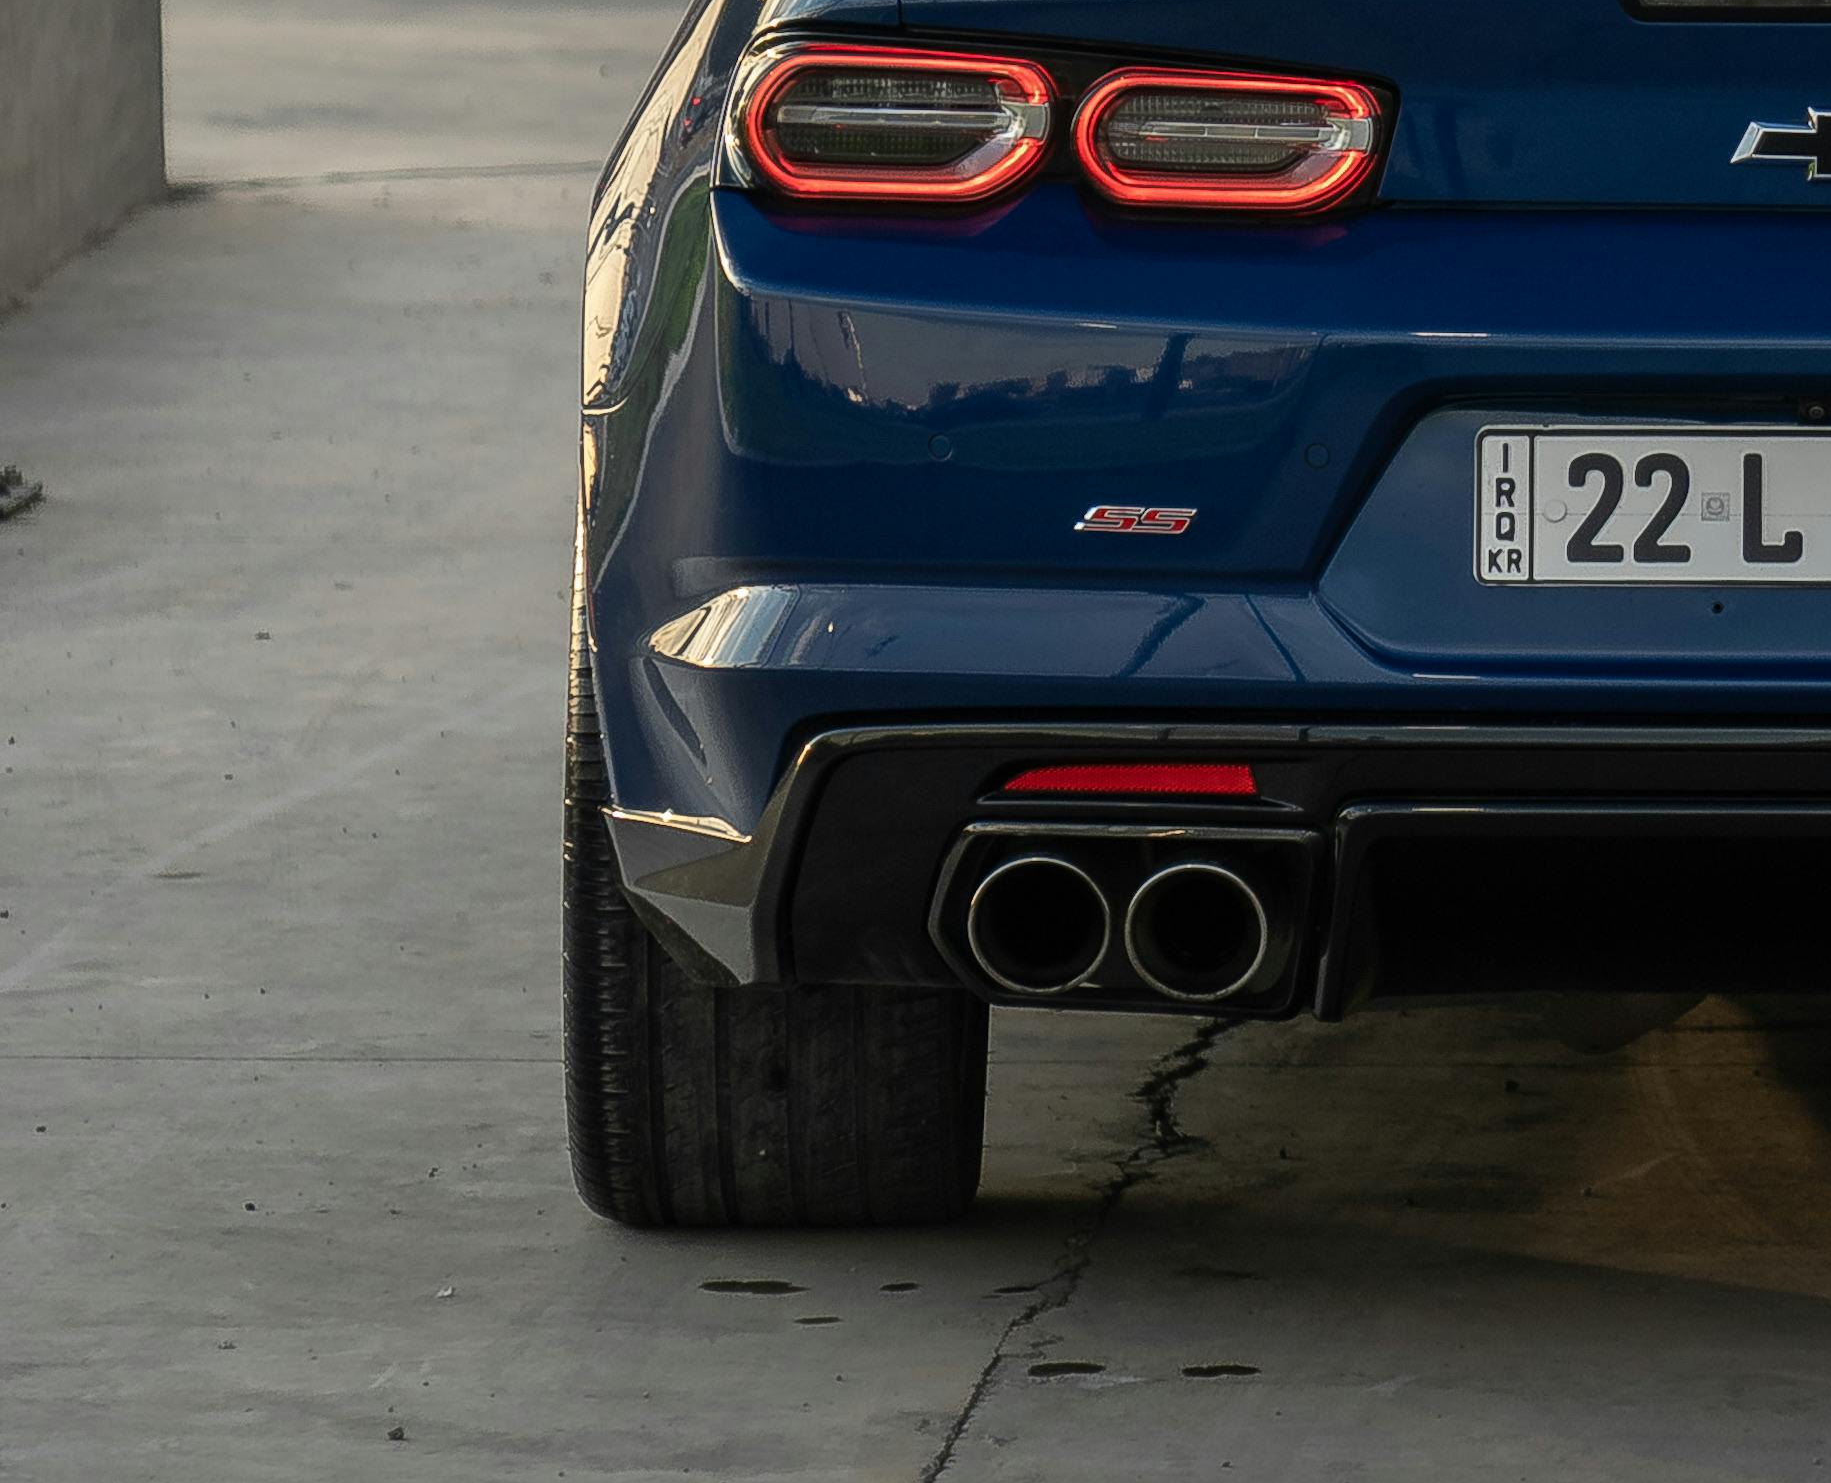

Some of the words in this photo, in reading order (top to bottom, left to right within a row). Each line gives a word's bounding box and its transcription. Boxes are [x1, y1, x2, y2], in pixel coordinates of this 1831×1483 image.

[1073, 504, 1198, 535] SS
[1565, 452, 1692, 564] 22
[1742, 452, 1804, 564] L
[1488, 548, 1522, 573] KR
